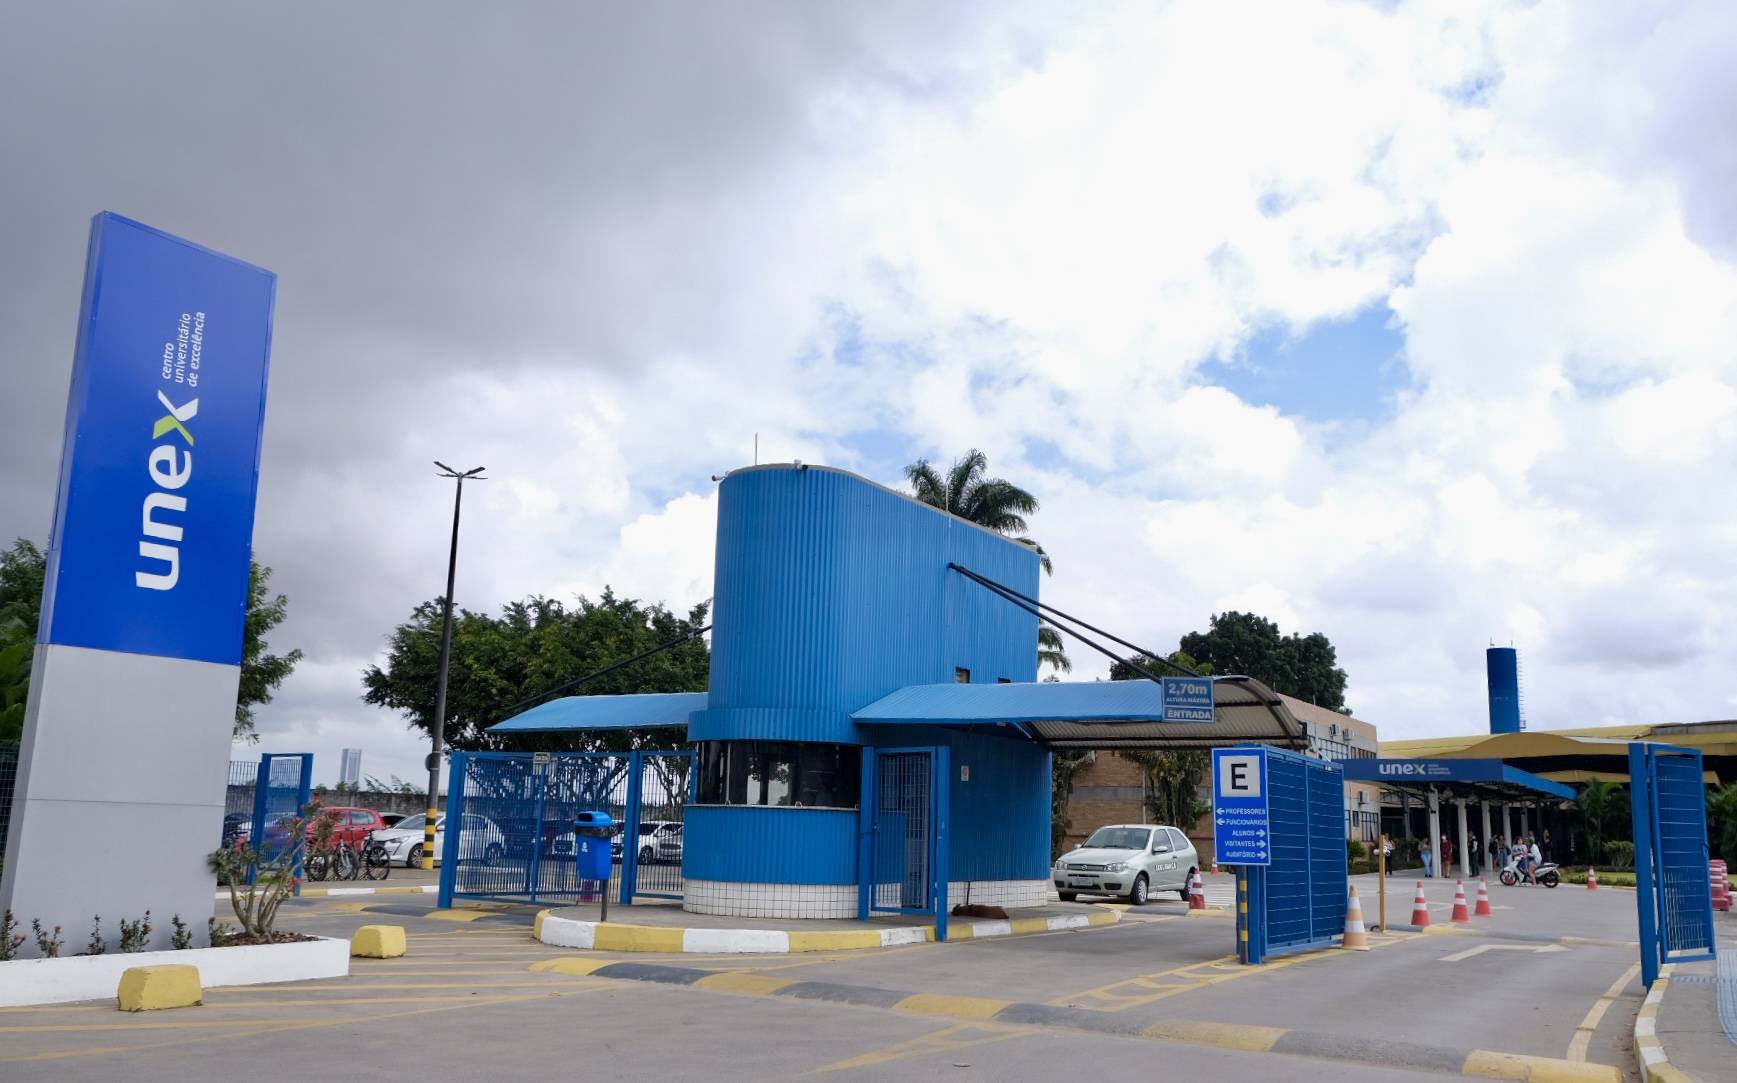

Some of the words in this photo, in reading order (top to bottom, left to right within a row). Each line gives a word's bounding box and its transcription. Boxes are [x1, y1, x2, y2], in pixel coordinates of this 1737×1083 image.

[189, 311, 206, 370] excelência
[174, 313, 191, 384] universitário
[162, 342, 175, 380] centro
[187, 372, 199, 388] de
[135, 389, 200, 591] unex
[1168, 683, 1208, 697] 2,70m
[1168, 710, 1212, 720] ENTRADA
[1231, 763, 1249, 790] E
[1378, 763, 1427, 775] unex
[1225, 818, 1267, 826] FUNCIONÁRIOS
[1224, 840, 1257, 848] VISITANTES
[1225, 850, 1257, 858] AUDITÓRIO
